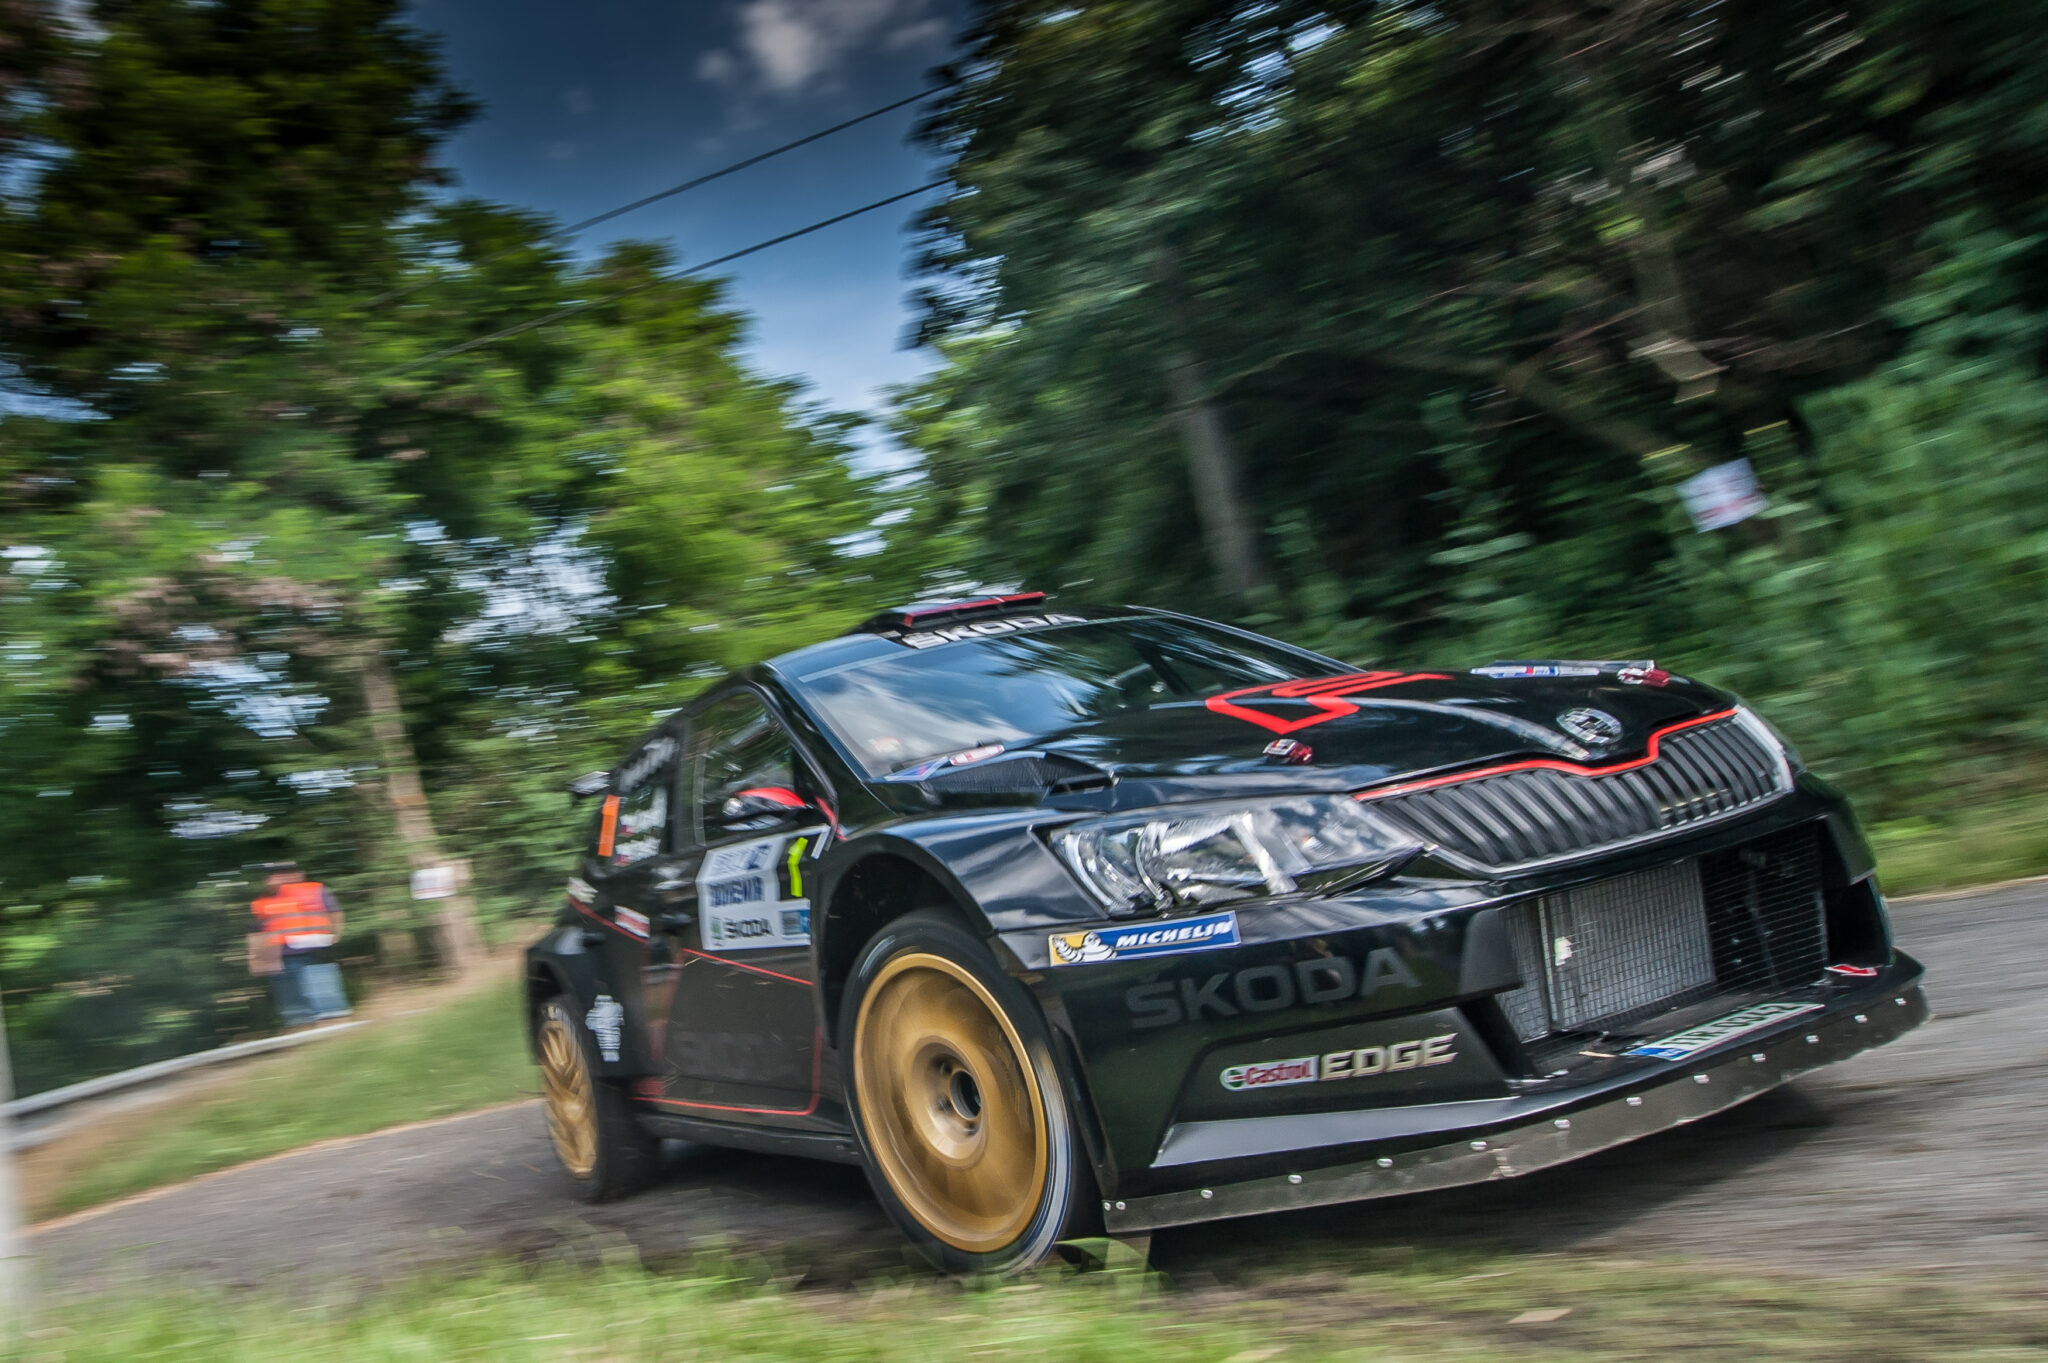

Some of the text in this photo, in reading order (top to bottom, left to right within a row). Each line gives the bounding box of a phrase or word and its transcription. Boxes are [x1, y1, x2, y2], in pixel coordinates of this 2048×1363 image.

[787, 837, 809, 898] 1
[1115, 919, 1235, 948] MICHELIN
[1244, 1032, 1459, 1086] Castrol EDGE
